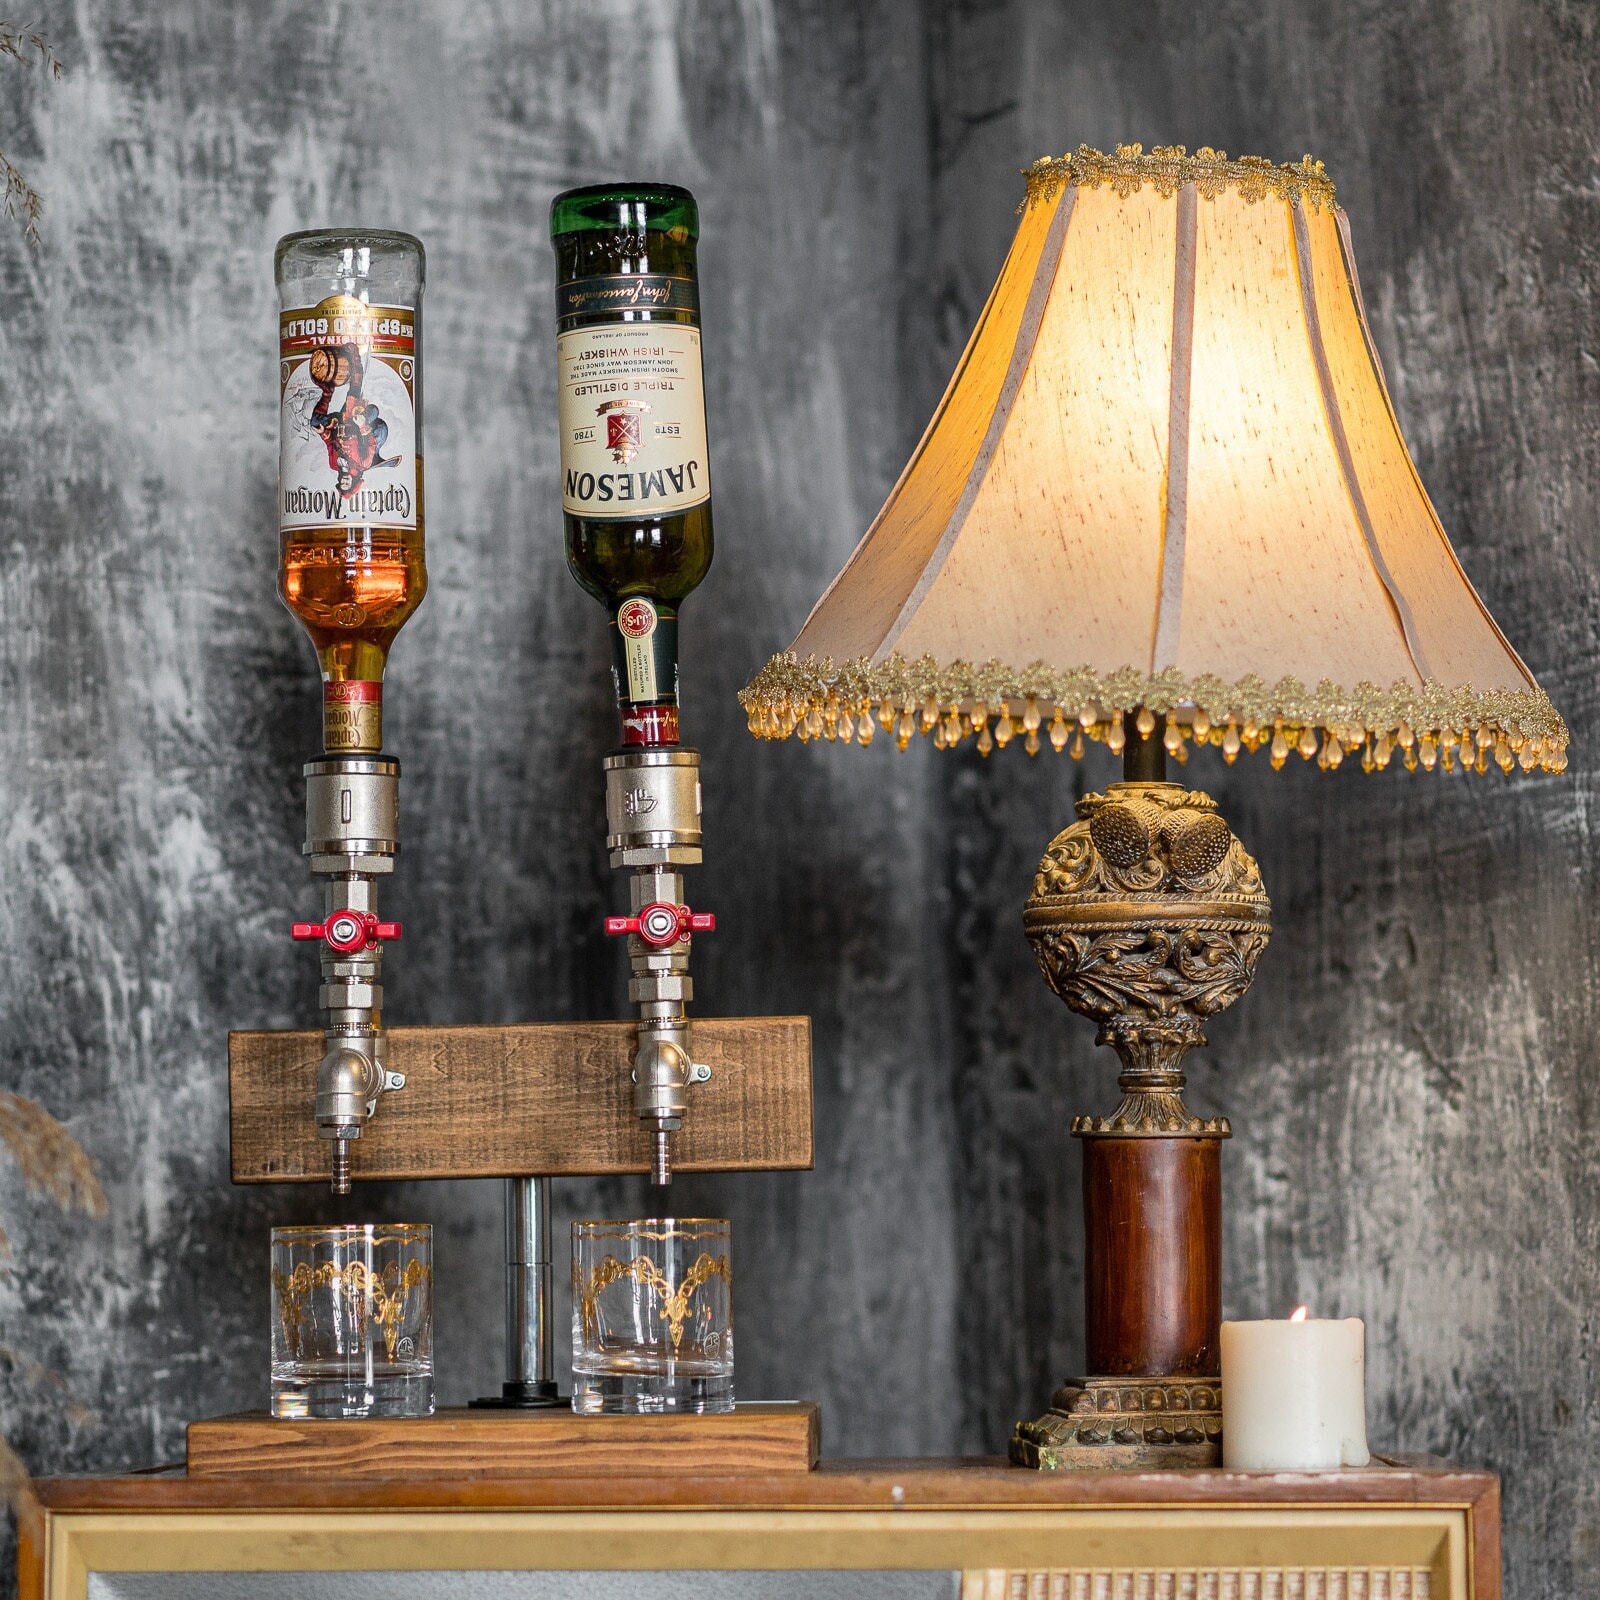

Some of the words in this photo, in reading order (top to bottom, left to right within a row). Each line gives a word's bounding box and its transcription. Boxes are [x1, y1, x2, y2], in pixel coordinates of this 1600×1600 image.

[288, 318, 328, 338] GOLD
[333, 317, 400, 336] SPID
[578, 348, 628, 361] WHISKEY
[633, 347, 664, 356] IRISH
[574, 382, 628, 396] DISTILLED
[633, 382, 674, 390] TRIPLE
[574, 430, 594, 440] 1780
[566, 460, 698, 502] JAMESON
[283, 486, 346, 520] Morgan
[349, 483, 410, 520] Captain
